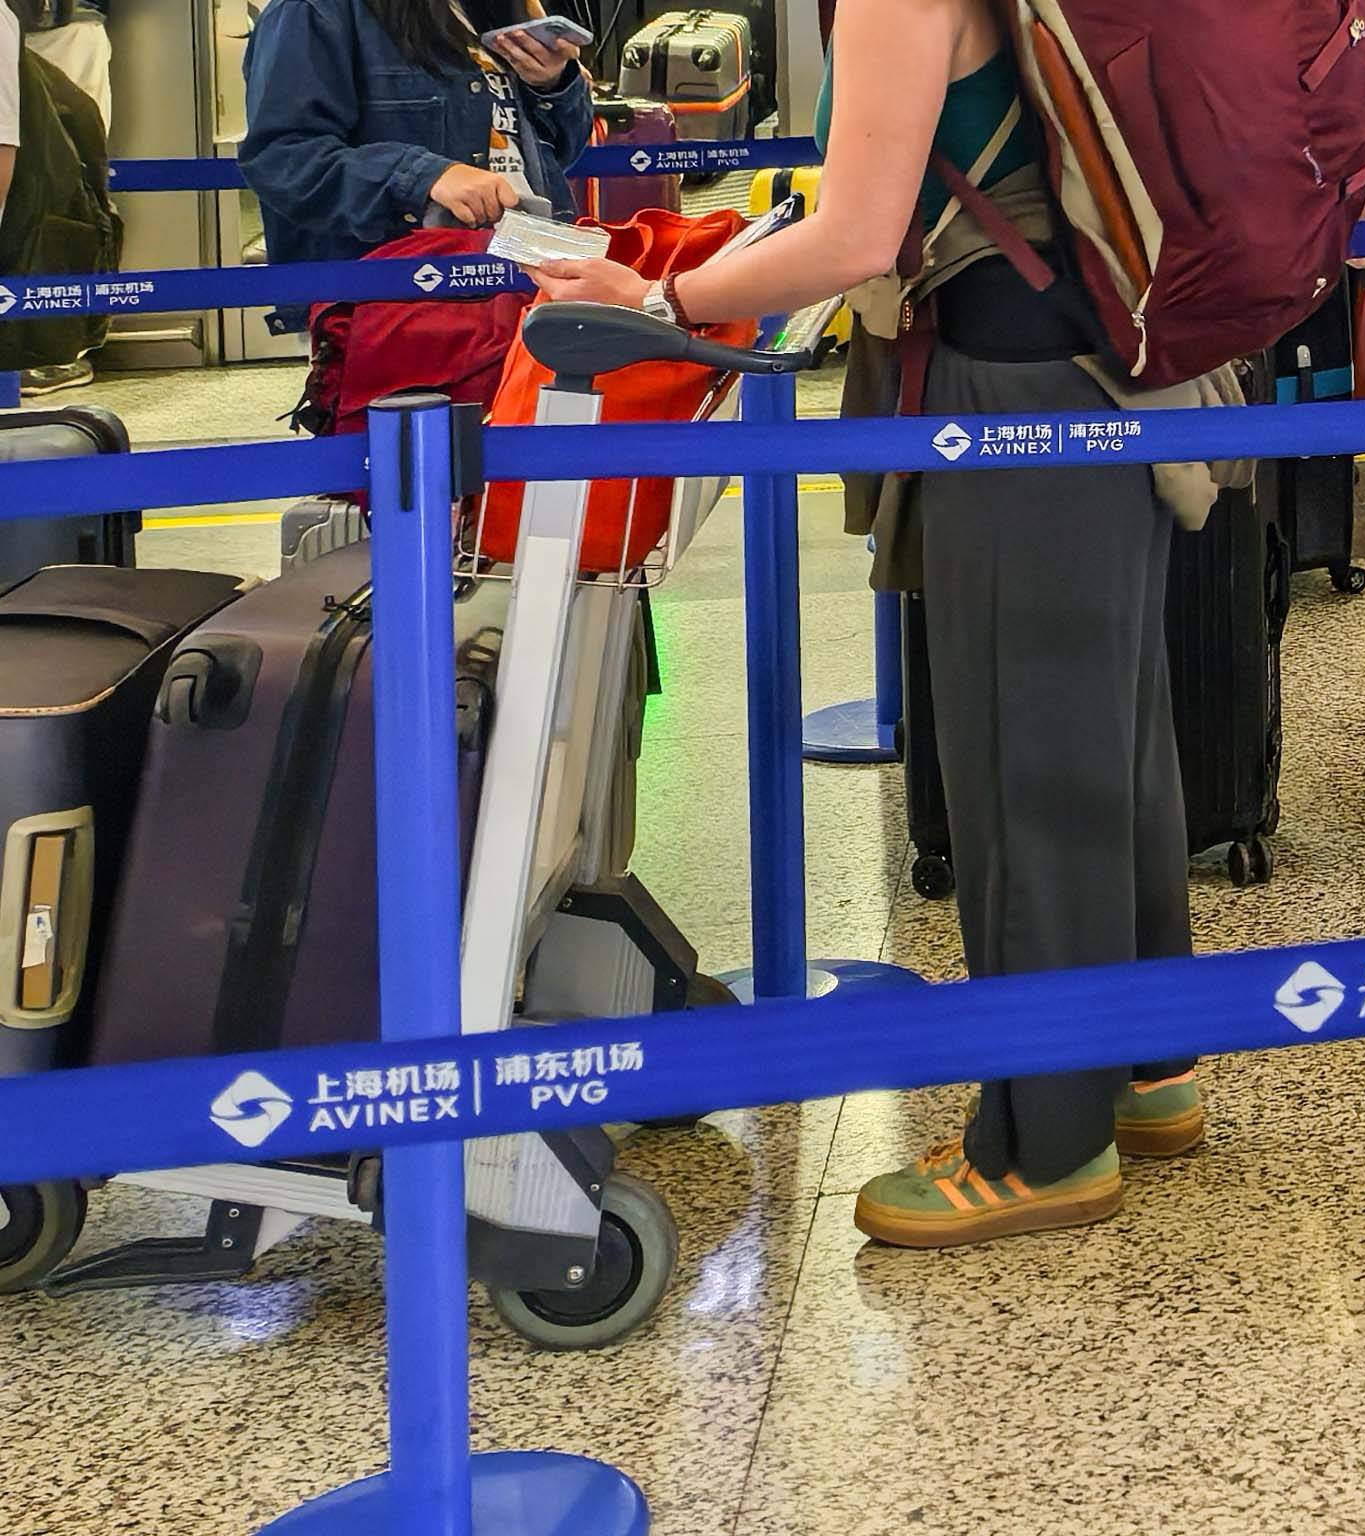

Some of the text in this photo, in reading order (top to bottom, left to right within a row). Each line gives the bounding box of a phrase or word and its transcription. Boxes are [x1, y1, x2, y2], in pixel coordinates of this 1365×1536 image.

[449, 264, 505, 279] 上海机场
[449, 274, 505, 288] AVINEX
[22, 281, 154, 301] 上海机场 浦东机场
[22, 294, 140, 310] AVINEX PVG
[978, 420, 1141, 441] 上海机场 浦东机场
[978, 437, 1124, 456] AVINEX PVG
[309, 1042, 643, 1105] 上海机场 浦东机场
[309, 1083, 608, 1132] AVINEX PVG
